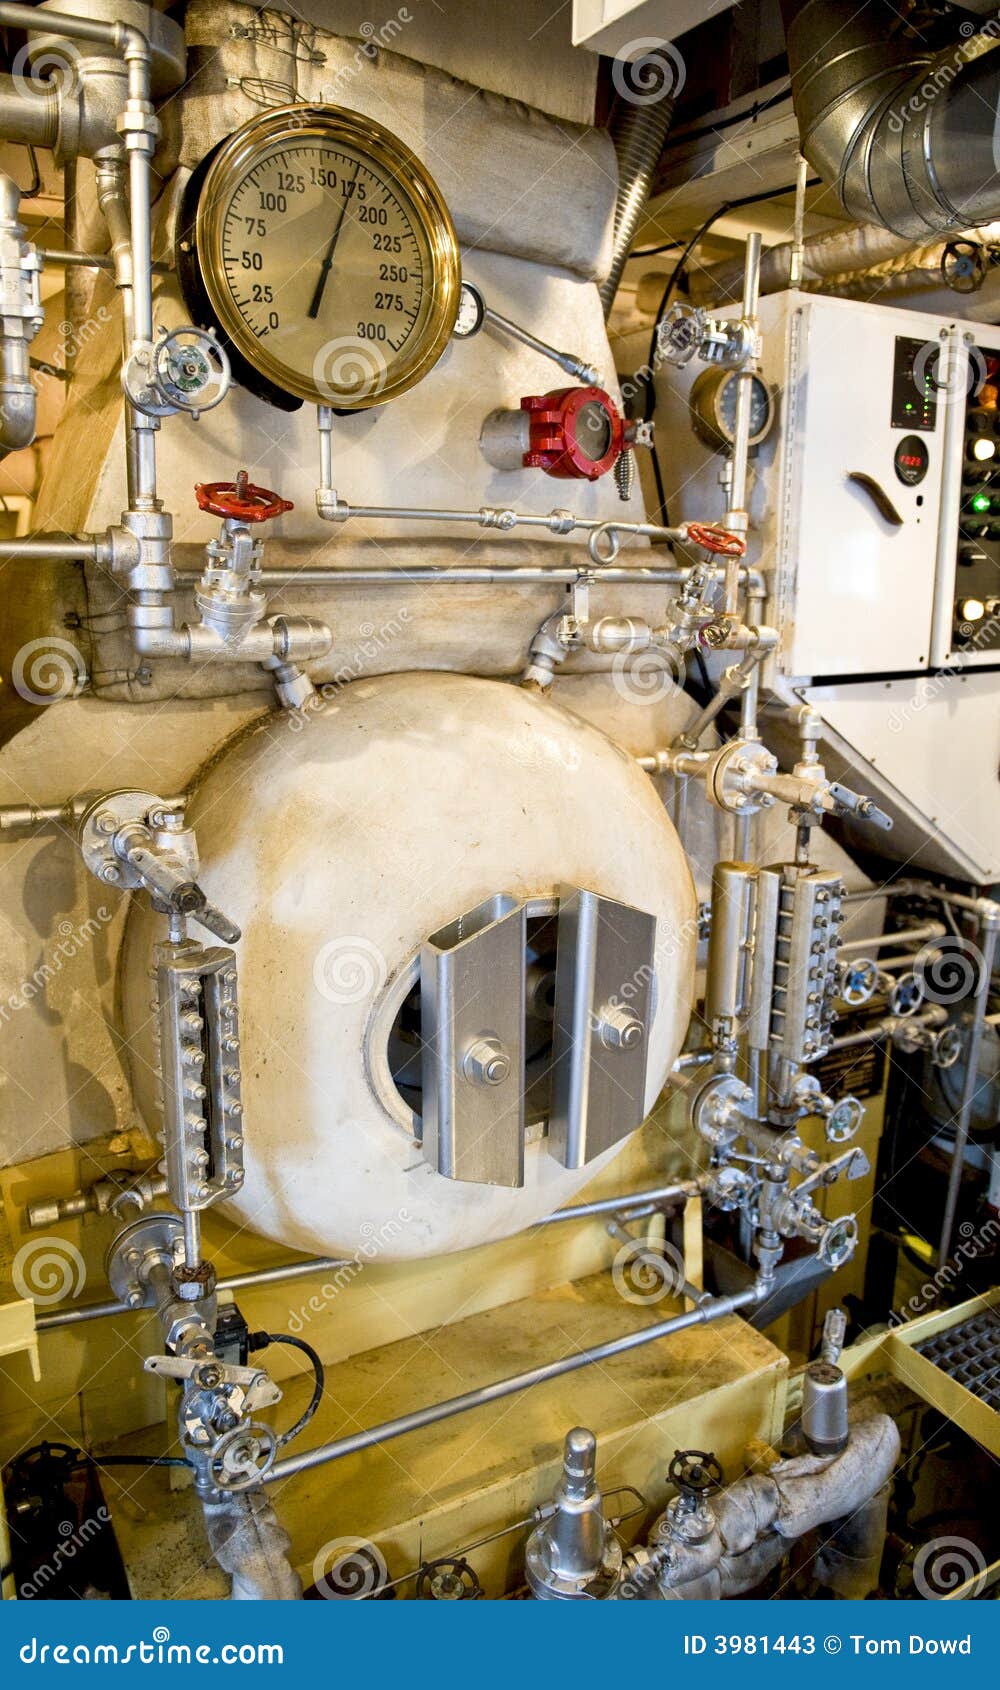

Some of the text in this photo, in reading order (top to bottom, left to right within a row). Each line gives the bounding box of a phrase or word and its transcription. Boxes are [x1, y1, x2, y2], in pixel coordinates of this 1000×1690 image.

[278, 172, 306, 194] 125
[310, 167, 337, 189] 150
[341, 179, 366, 200] 175
[260, 191, 287, 213] 100
[358, 205, 388, 226] 200
[245, 217, 266, 237] 75
[373, 234, 402, 253] 225
[242, 251, 263, 271] 50
[379, 264, 408, 283] 250
[252, 284, 274, 304] 25
[374, 293, 404, 312] 275
[268, 312, 280, 330] 0
[356, 322, 387, 341] 300
